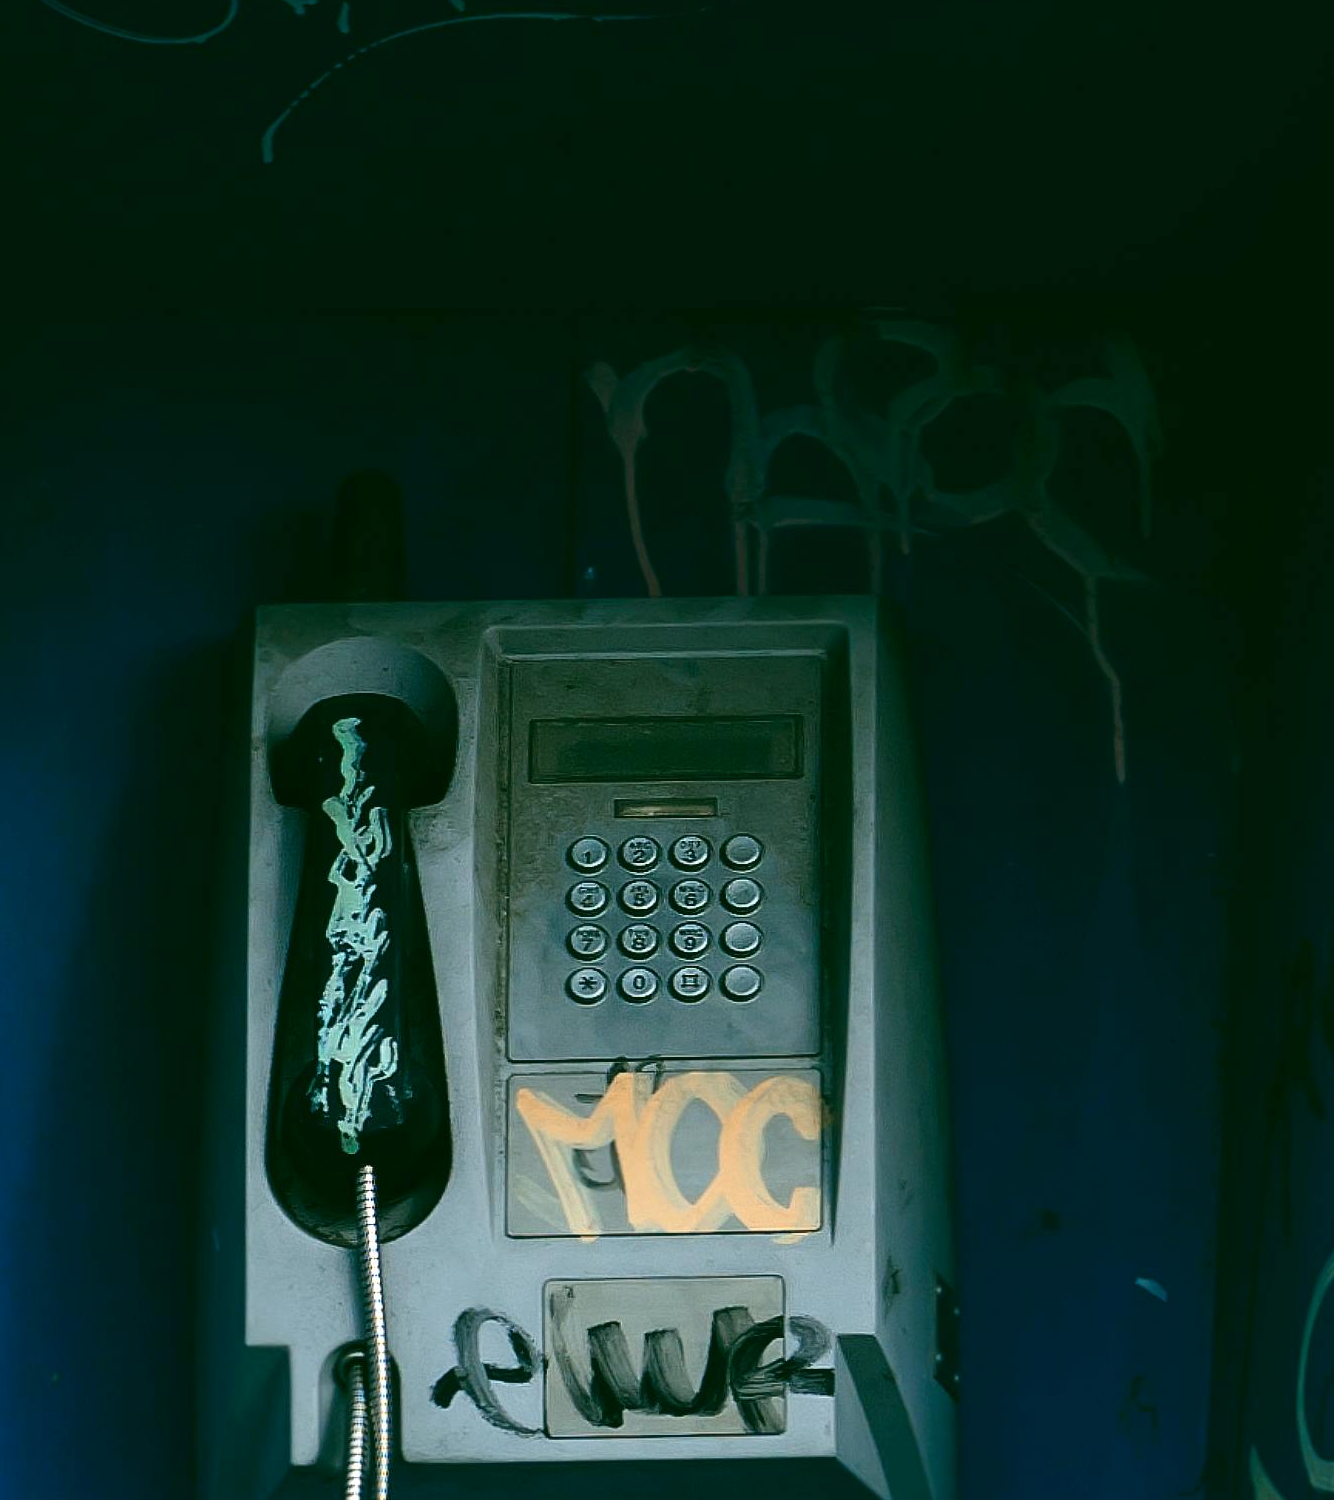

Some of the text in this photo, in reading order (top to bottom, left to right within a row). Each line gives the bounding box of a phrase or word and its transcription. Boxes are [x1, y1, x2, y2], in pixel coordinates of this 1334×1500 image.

[583, 850, 592, 865] 1
[633, 849, 646, 863] 2
[680, 849, 697, 863] 3
[633, 893, 647, 906] 5
[684, 893, 697, 906] 6
[581, 937, 594, 951] 7
[631, 937, 648, 950] 8
[684, 936, 696, 950] 9
[632, 974, 646, 990] 0
